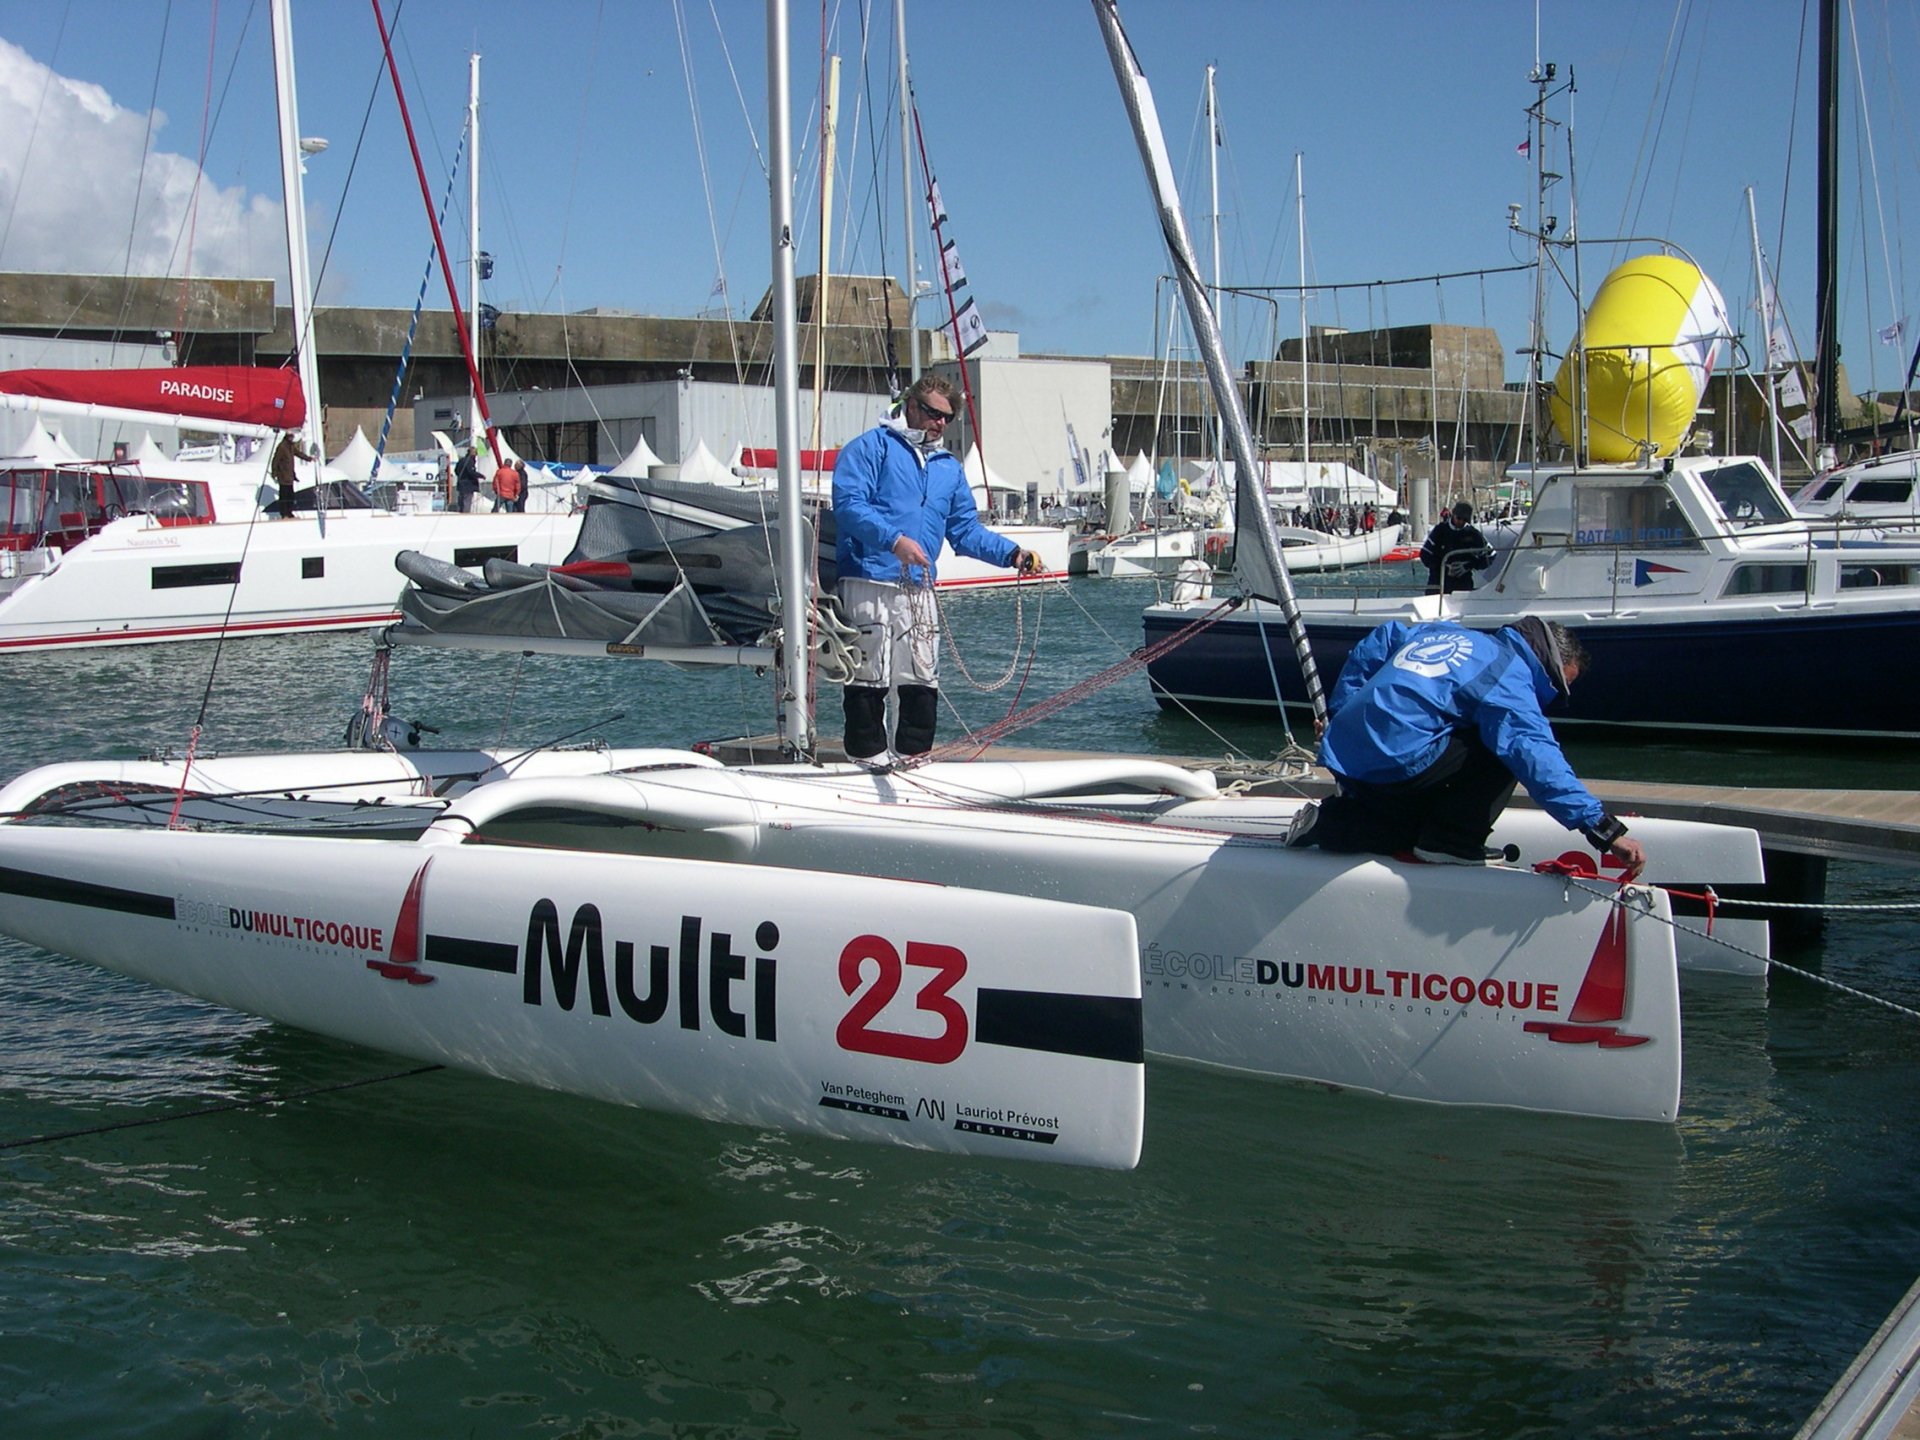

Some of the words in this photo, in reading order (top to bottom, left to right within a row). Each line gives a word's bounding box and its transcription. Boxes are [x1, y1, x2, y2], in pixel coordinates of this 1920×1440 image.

[160, 380, 234, 403] PARADISE
[523, 897, 780, 1043] Multi
[836, 934, 969, 1065] 23
[821, 1081, 843, 1096] Van
[847, 1085, 905, 1105] Peteghem
[843, 1102, 902, 1119] YACHT
[956, 1103, 1003, 1121] Lauriot
[1007, 1108, 1060, 1129] Prévost
[962, 1122, 1036, 1140] DESIGN
